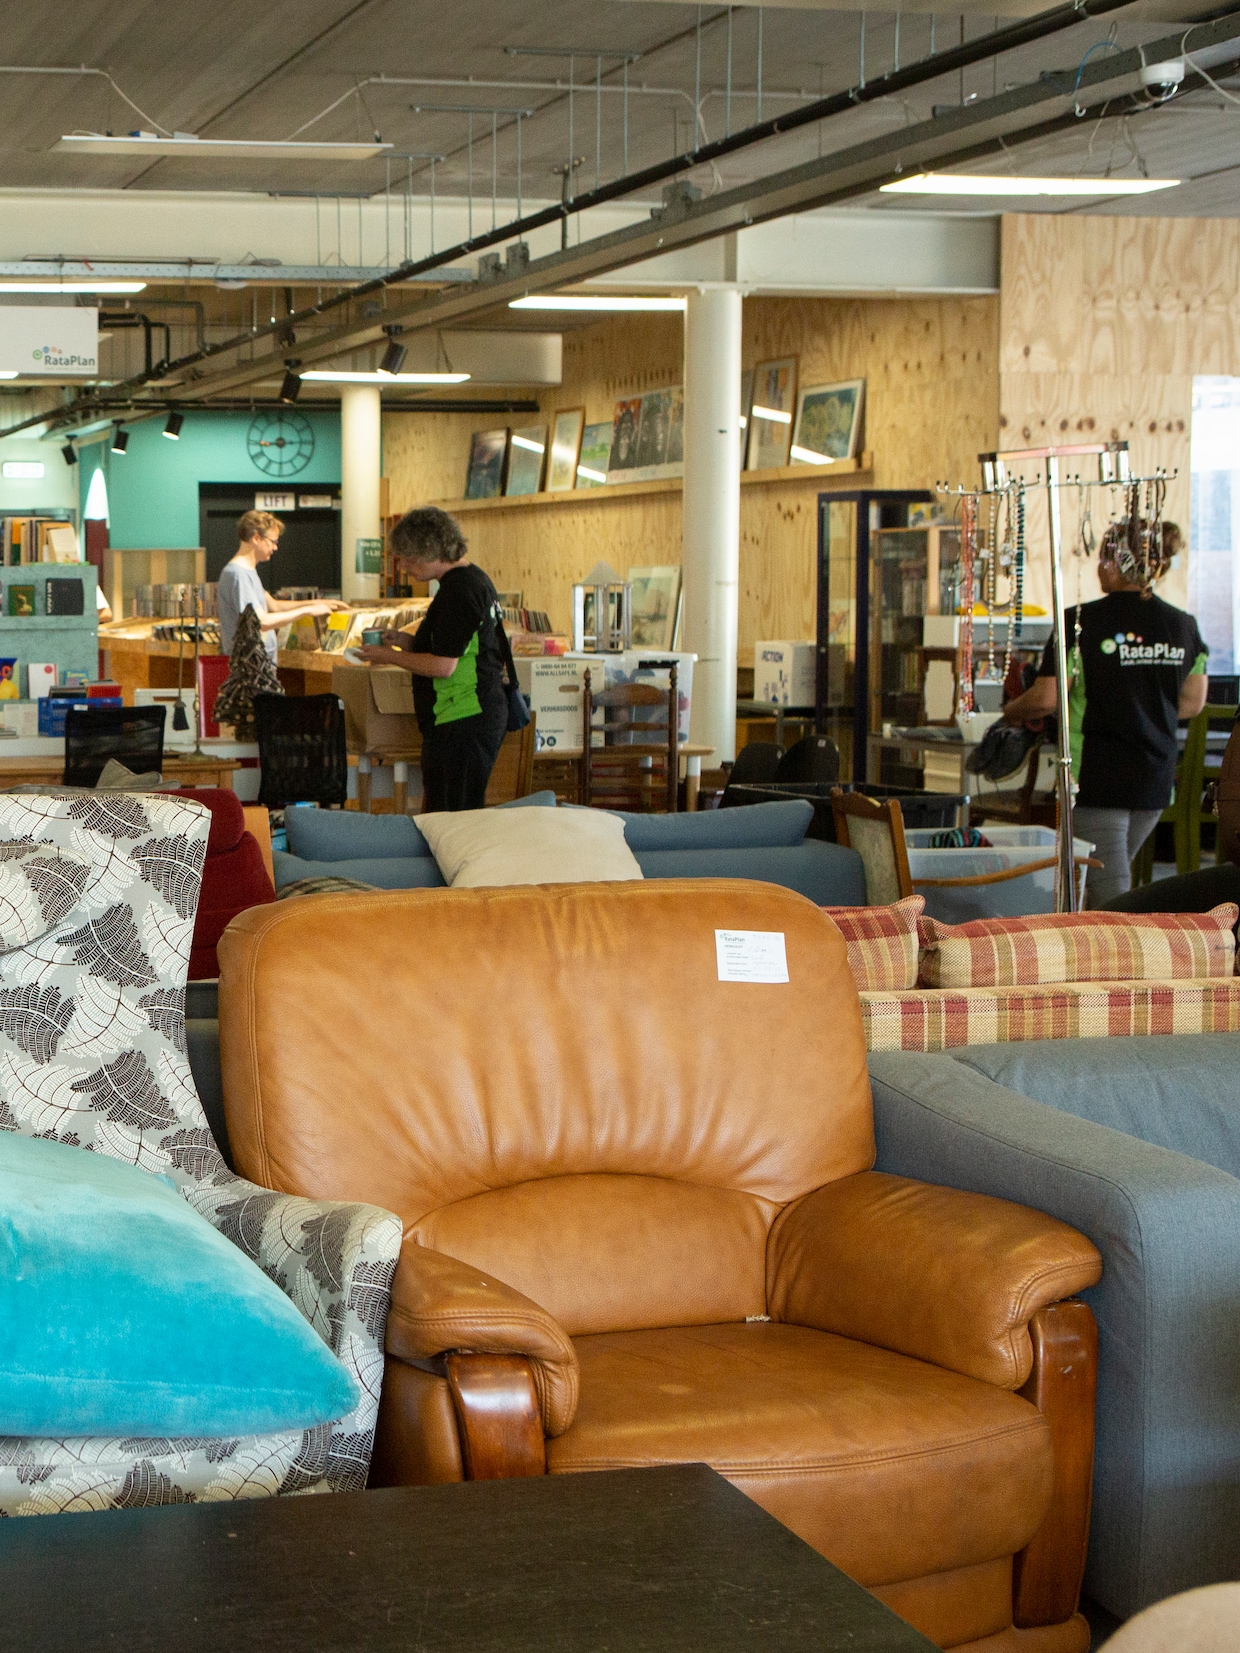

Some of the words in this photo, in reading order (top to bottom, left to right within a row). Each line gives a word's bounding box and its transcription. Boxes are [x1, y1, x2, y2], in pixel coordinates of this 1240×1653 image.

[44, 355, 95, 366] RataPlan
[263, 495, 287, 507] LIFT
[762, 650, 784, 662] ACTION
[1119, 643, 1186, 660] RataPlan
[540, 704, 578, 712] VERHUISDOOS
